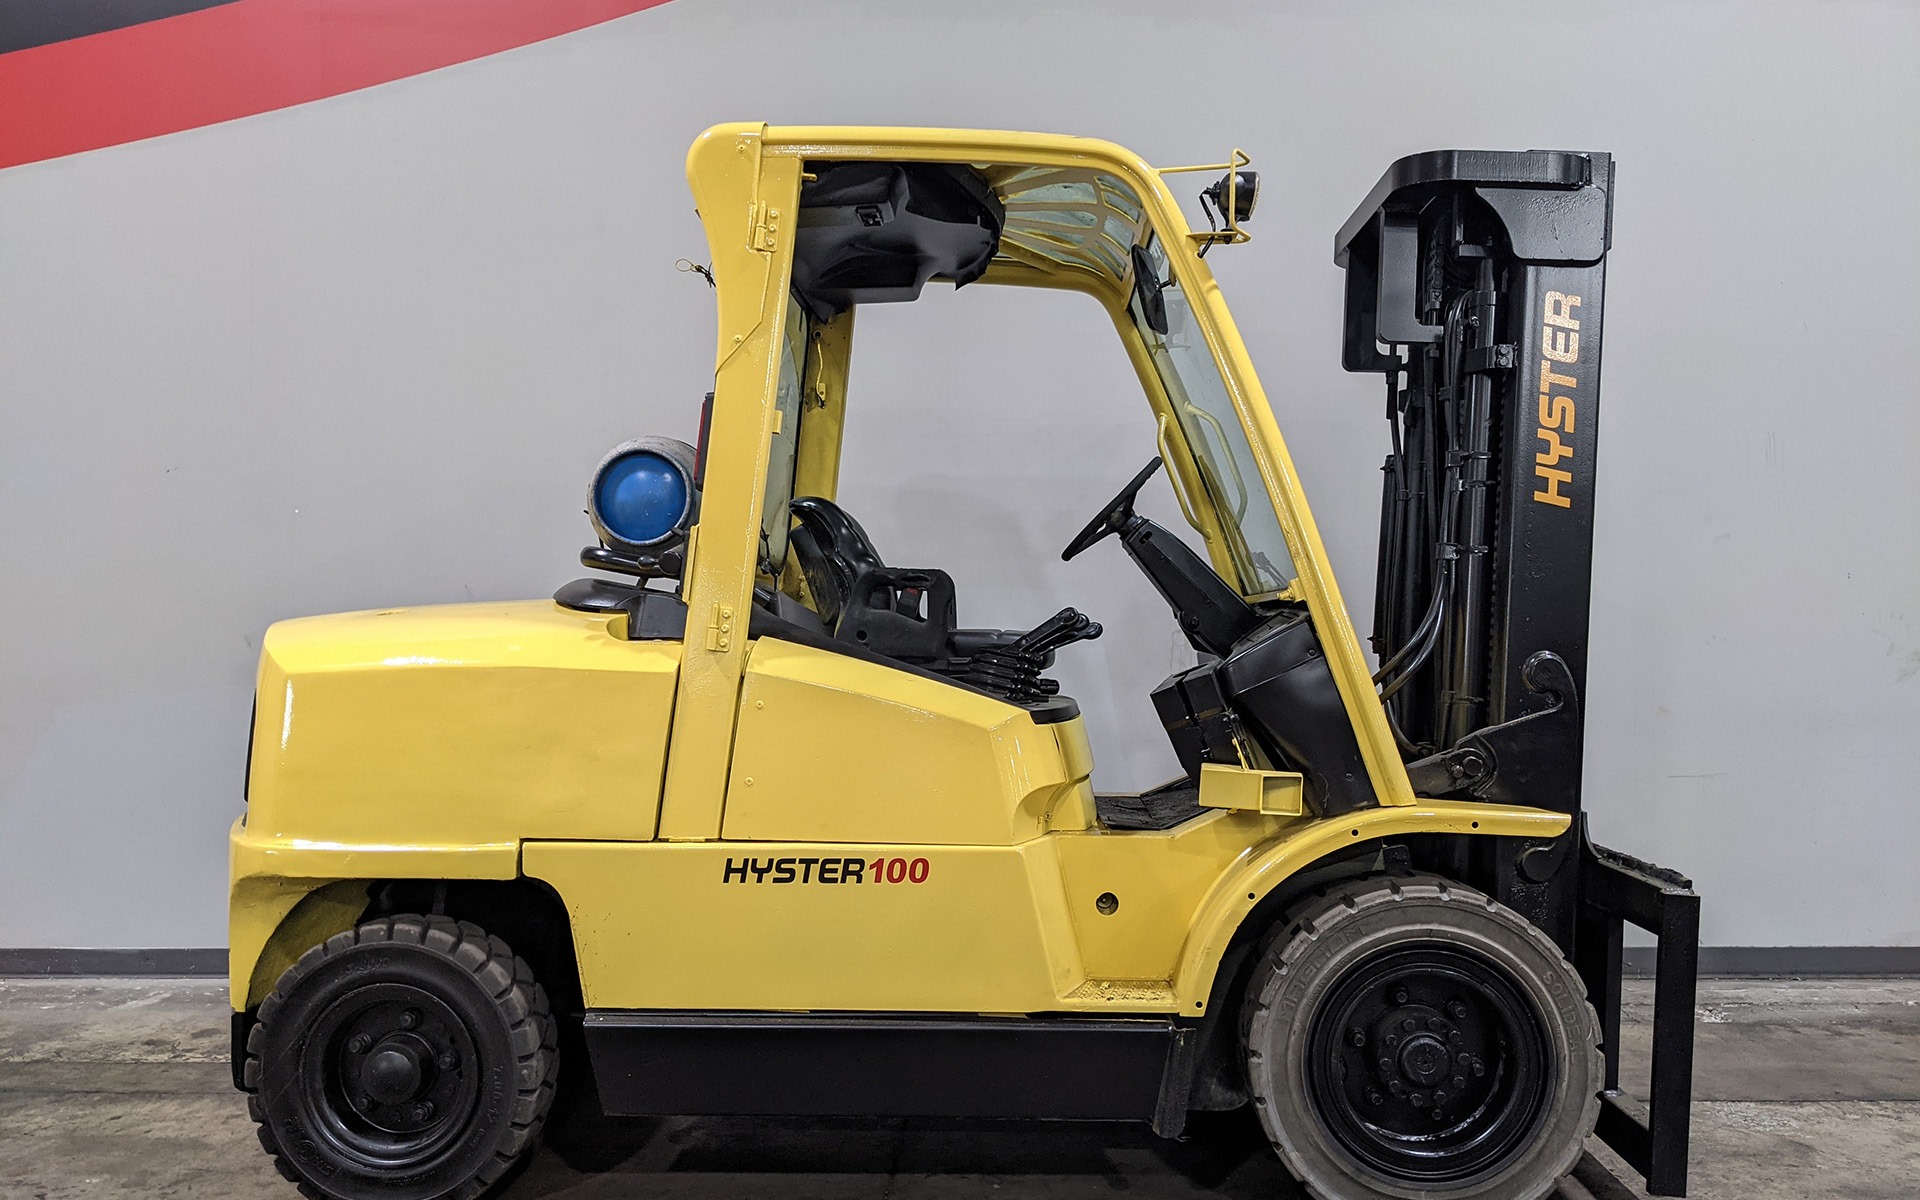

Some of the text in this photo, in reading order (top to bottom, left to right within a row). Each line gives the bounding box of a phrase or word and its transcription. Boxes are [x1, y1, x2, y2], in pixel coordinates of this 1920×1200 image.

[1534, 290, 1582, 508] HYSTER
[722, 857, 930, 884] HYSTER 100
[1277, 925, 1367, 1023] MAGNUM
[1542, 970, 1584, 1064] SOLIDEAL
